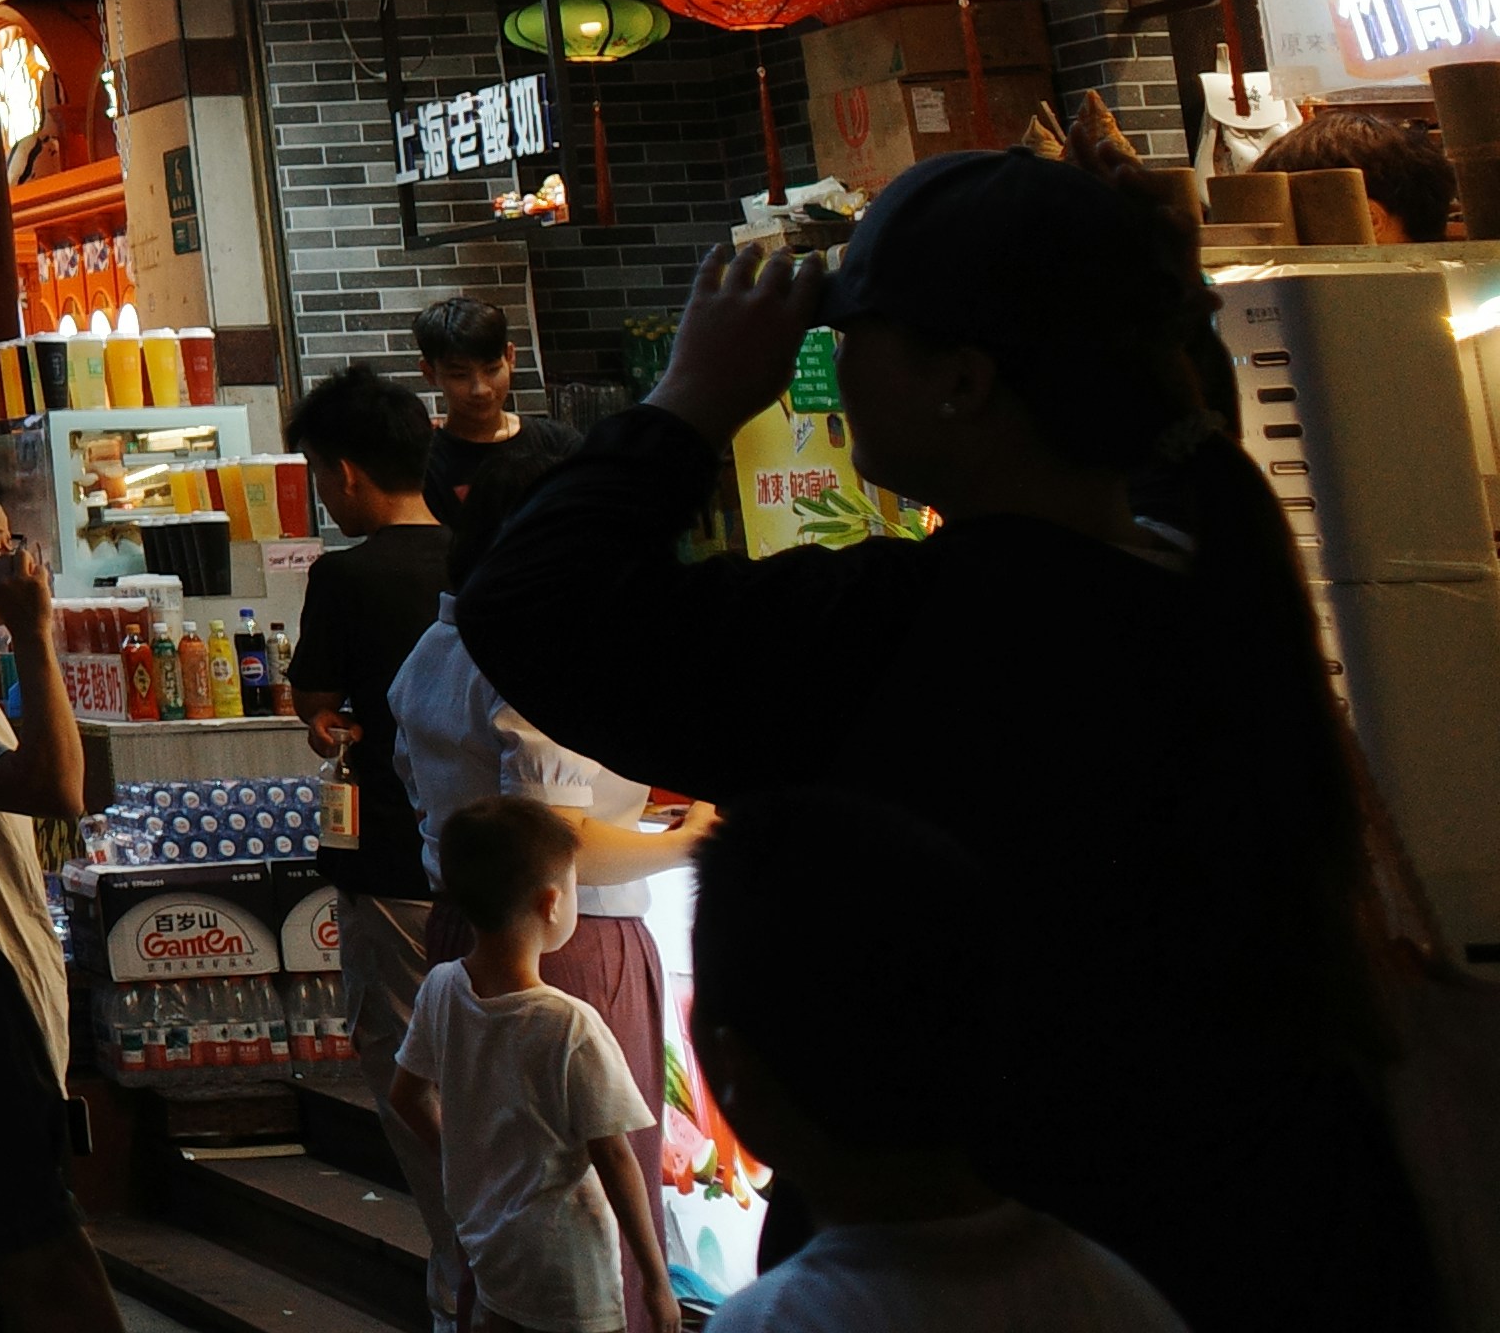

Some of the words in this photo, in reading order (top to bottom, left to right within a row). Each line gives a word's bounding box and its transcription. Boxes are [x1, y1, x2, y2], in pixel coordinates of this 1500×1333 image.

[394, 73, 547, 183] 上海老酸奶
[154, 911, 218, 932] 百岁山
